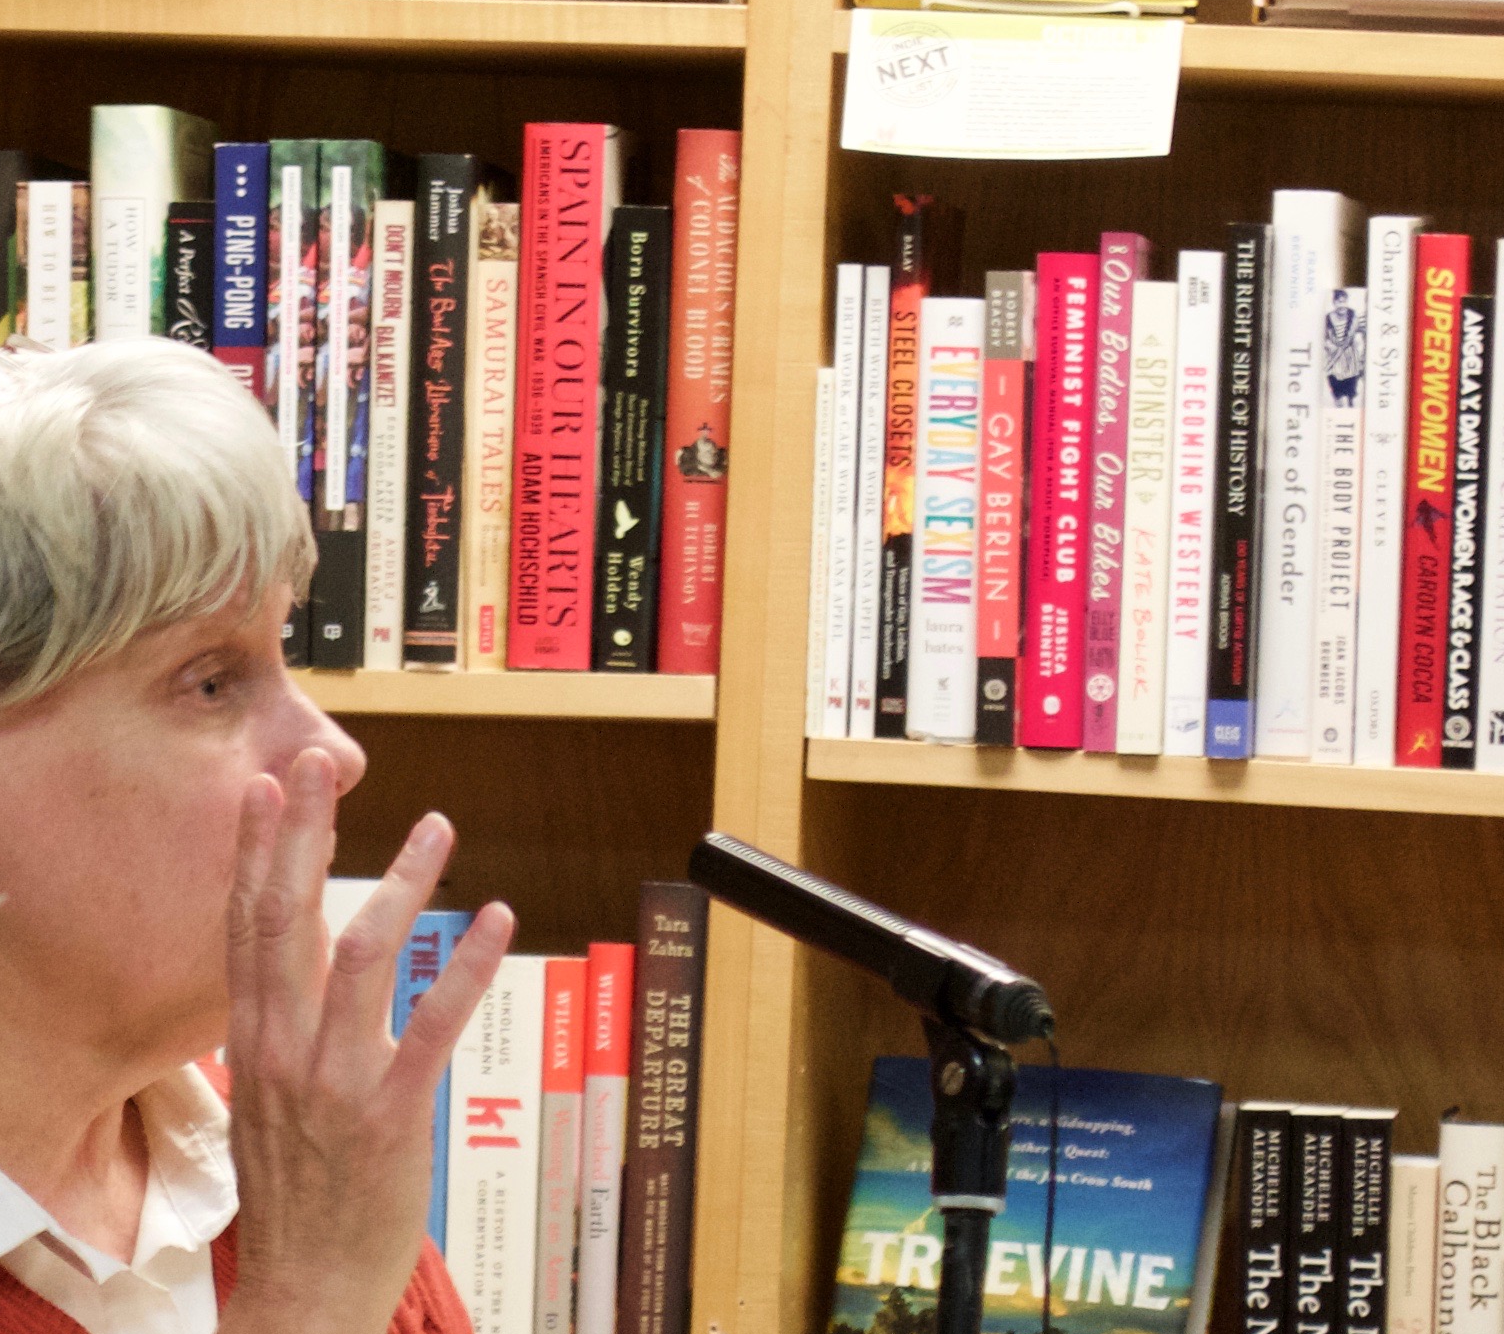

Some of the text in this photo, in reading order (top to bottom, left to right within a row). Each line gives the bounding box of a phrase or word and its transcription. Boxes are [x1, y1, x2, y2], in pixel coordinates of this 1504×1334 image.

[875, 46, 951, 85] NEXT
[545, 138, 591, 629] SPAIN IN OUR HEARTS
[921, 346, 980, 606] EVERYDAY SEXISM
[1055, 276, 1087, 585] FEMINIST FIGHT CLUB
[1417, 267, 1455, 494] SUPERWOMEN
[861, 1231, 1174, 1310] TREVINE
